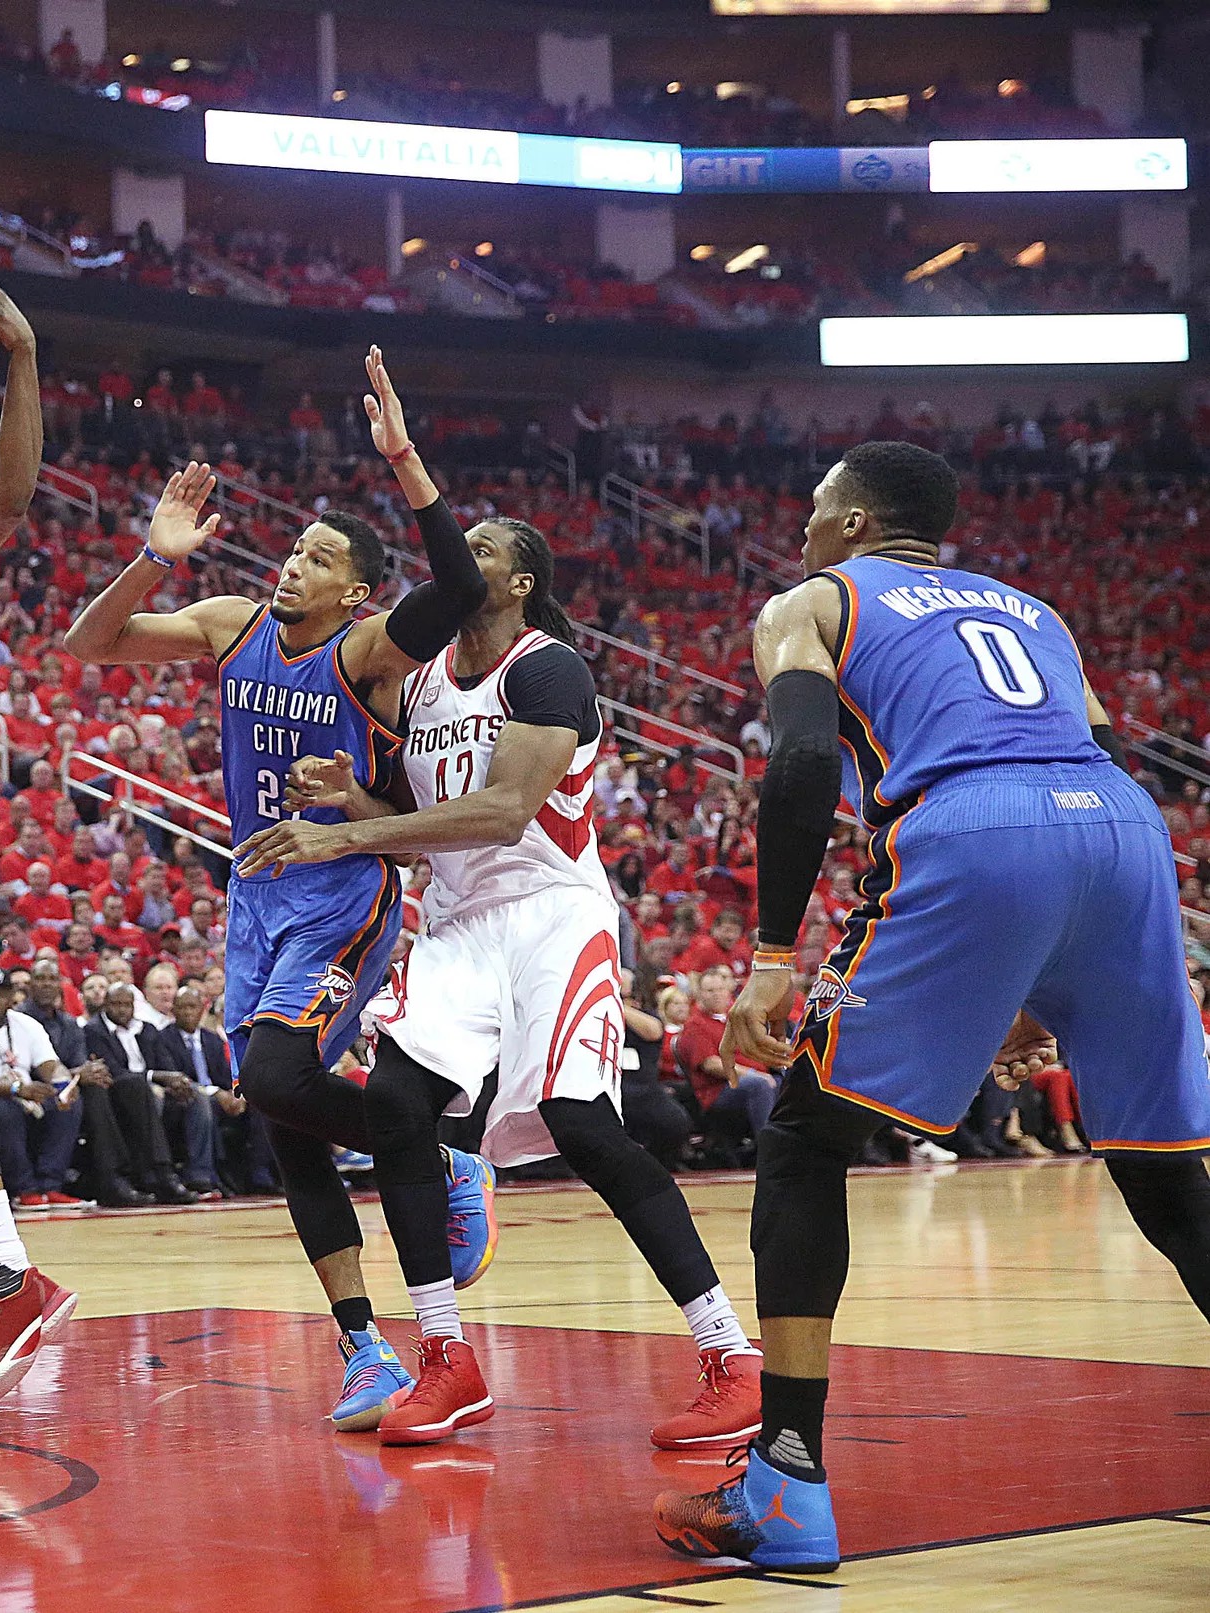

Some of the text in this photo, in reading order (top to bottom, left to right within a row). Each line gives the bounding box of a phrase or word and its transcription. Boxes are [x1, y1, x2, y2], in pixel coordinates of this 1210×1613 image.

[273, 131, 504, 168] VALVITALIA
[877, 584, 1042, 631] WESTBROOK
[956, 618, 1047, 708] 0
[226, 679, 339, 725] OKLAHOMA
[253, 723, 300, 757] CITY
[410, 714, 505, 757] ROCKETS
[435, 749, 474, 804] 42
[1050, 790, 1104, 809] THUNDER
